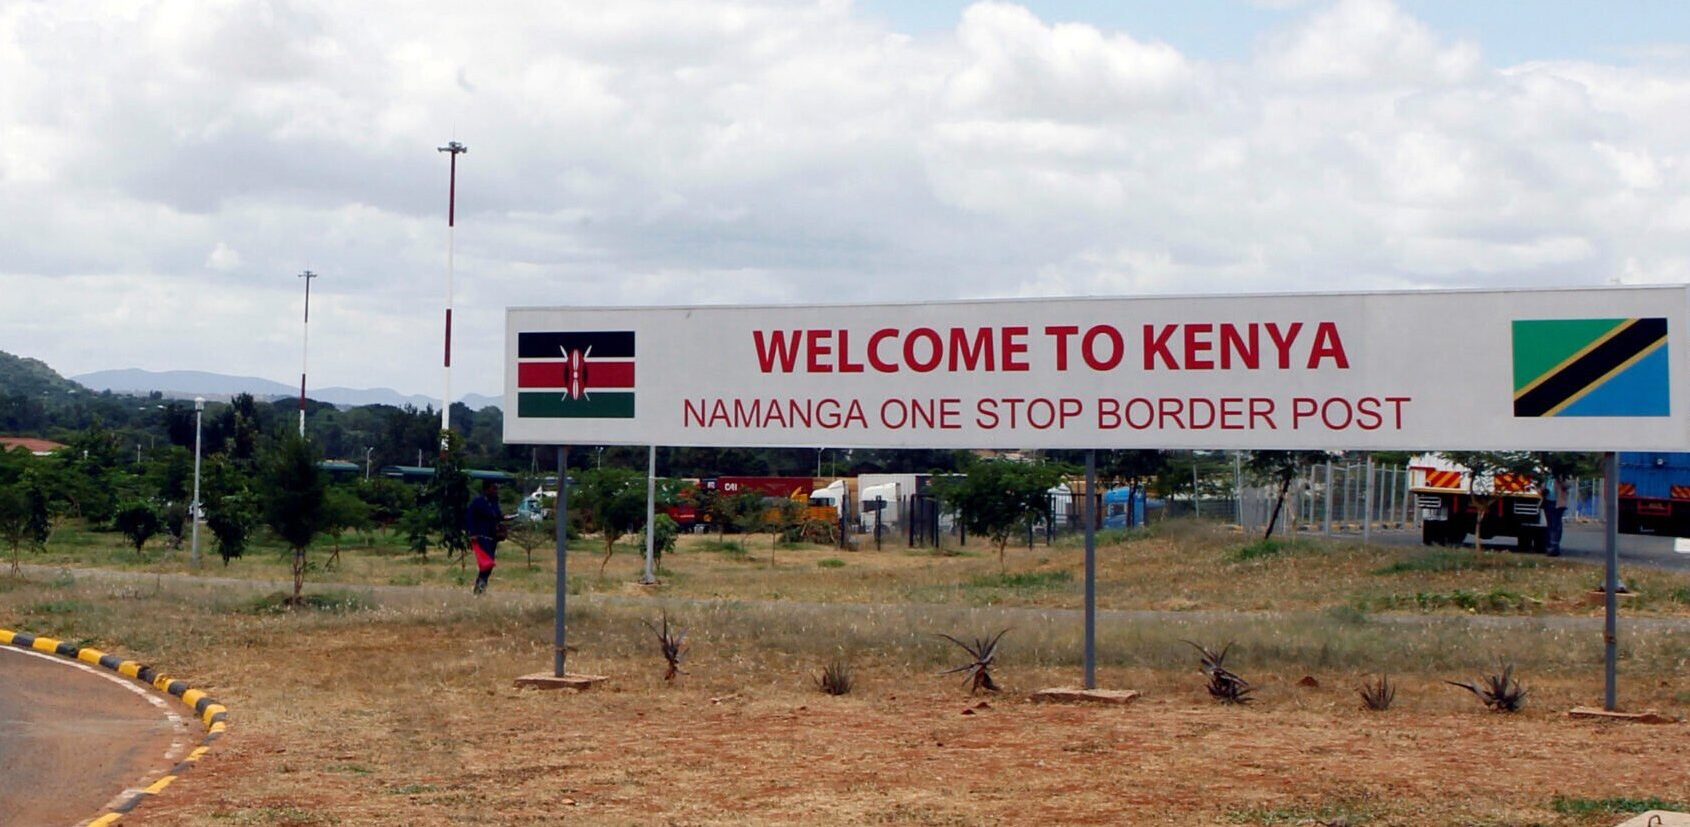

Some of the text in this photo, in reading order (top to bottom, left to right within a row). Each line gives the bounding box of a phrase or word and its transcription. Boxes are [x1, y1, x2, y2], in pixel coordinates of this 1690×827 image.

[753, 322, 1349, 373] WELCOME TO KENYA
[684, 397, 1411, 430] NAMANGA ONE STOP BORDER POST
